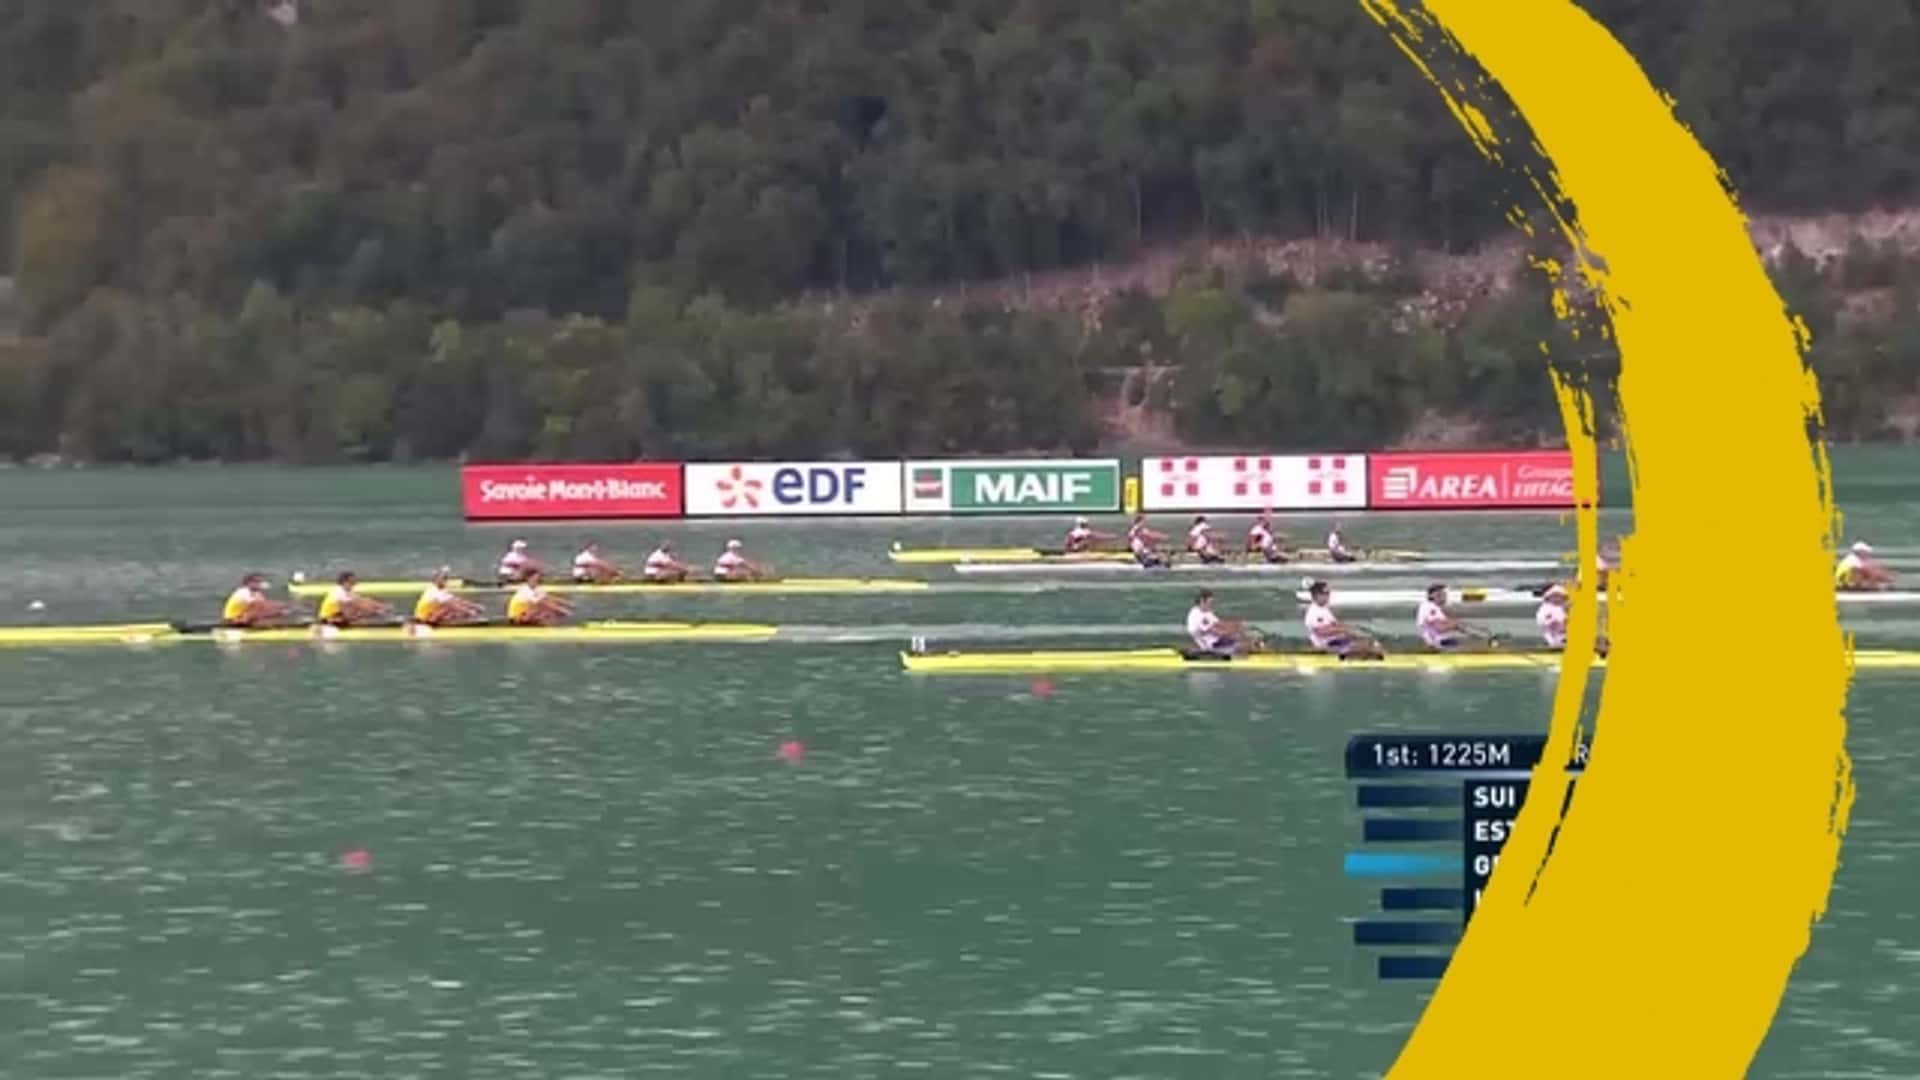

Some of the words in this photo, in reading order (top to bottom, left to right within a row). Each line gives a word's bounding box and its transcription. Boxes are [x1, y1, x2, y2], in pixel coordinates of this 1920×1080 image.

[480, 475, 547, 503] Savoie
[974, 472, 1091, 503] MAIF
[1418, 475, 1500, 499] AREA
[1512, 481, 1574, 497] EIFFAG
